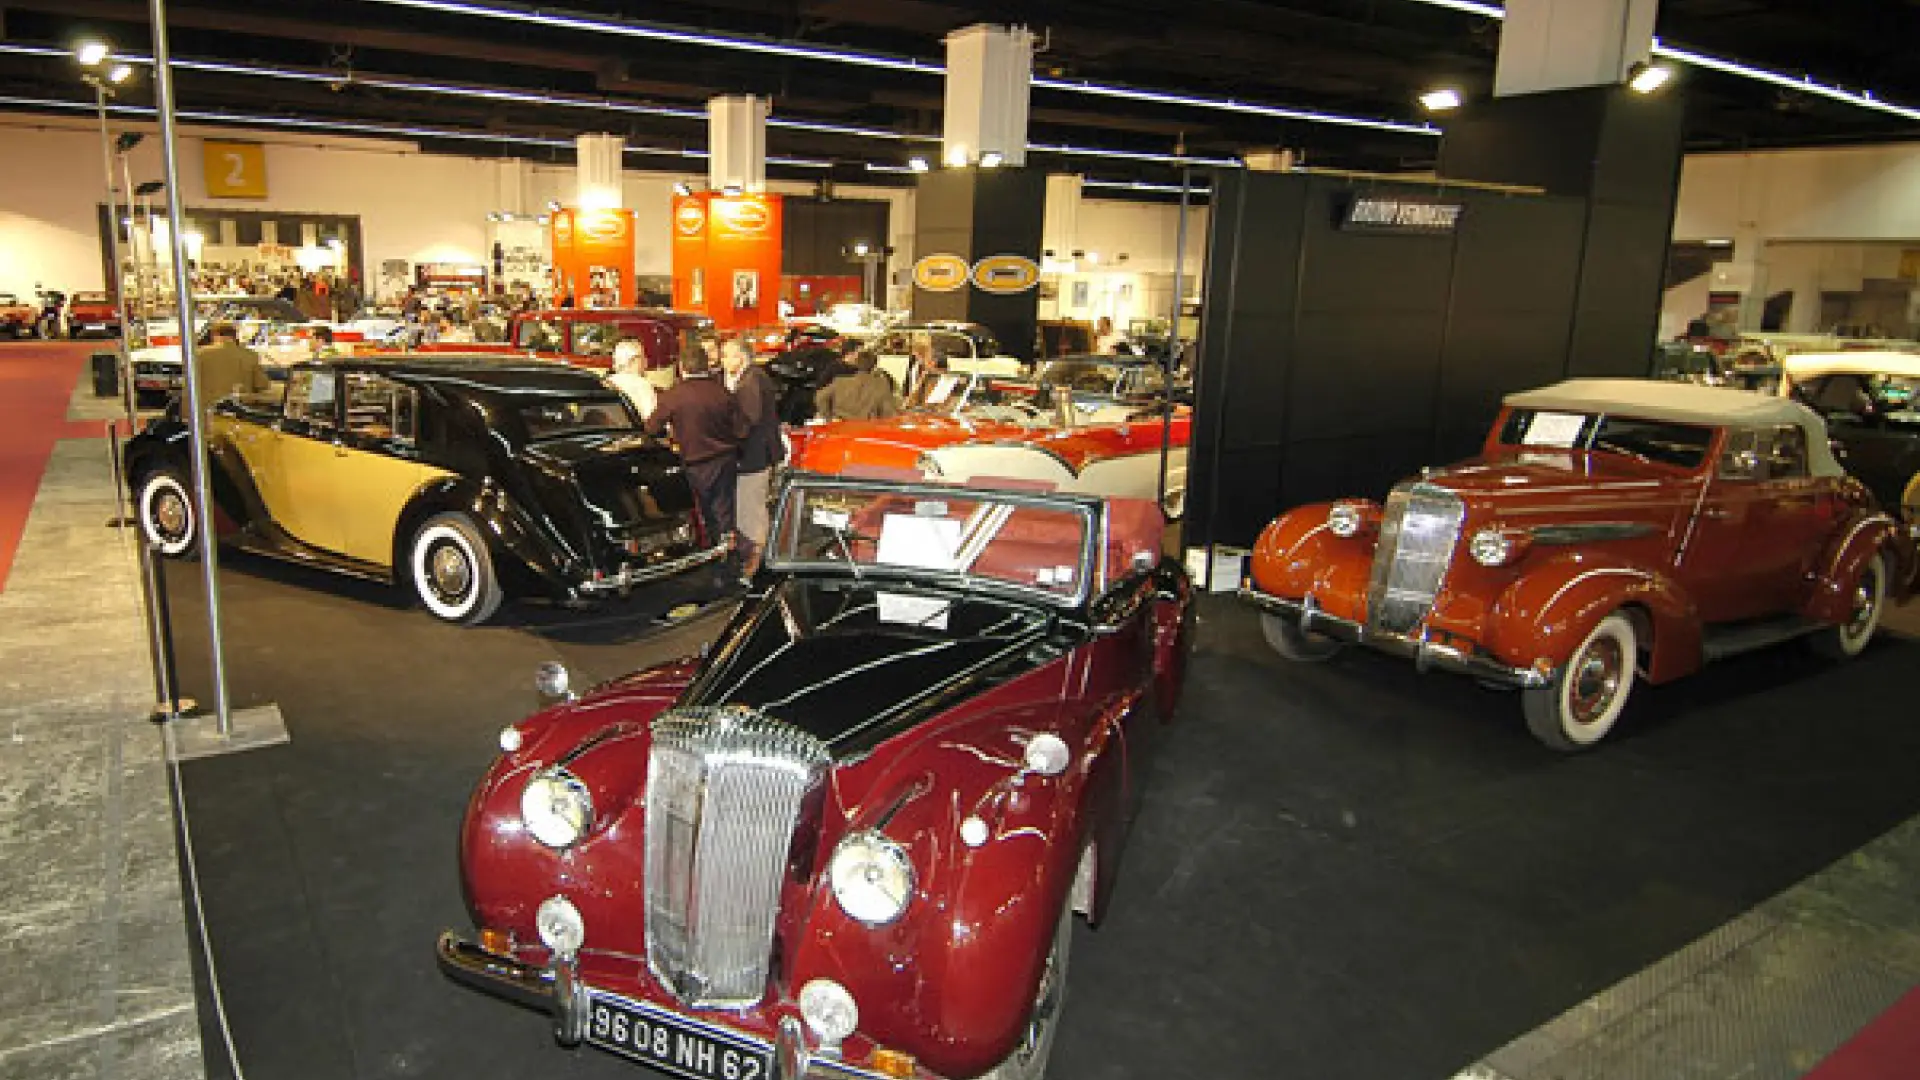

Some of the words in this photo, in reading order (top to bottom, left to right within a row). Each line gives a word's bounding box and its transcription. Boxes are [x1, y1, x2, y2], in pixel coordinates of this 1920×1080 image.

[223, 153, 247, 187] 2
[595, 1006, 668, 1058] 9608
[675, 1033, 715, 1074] NH
